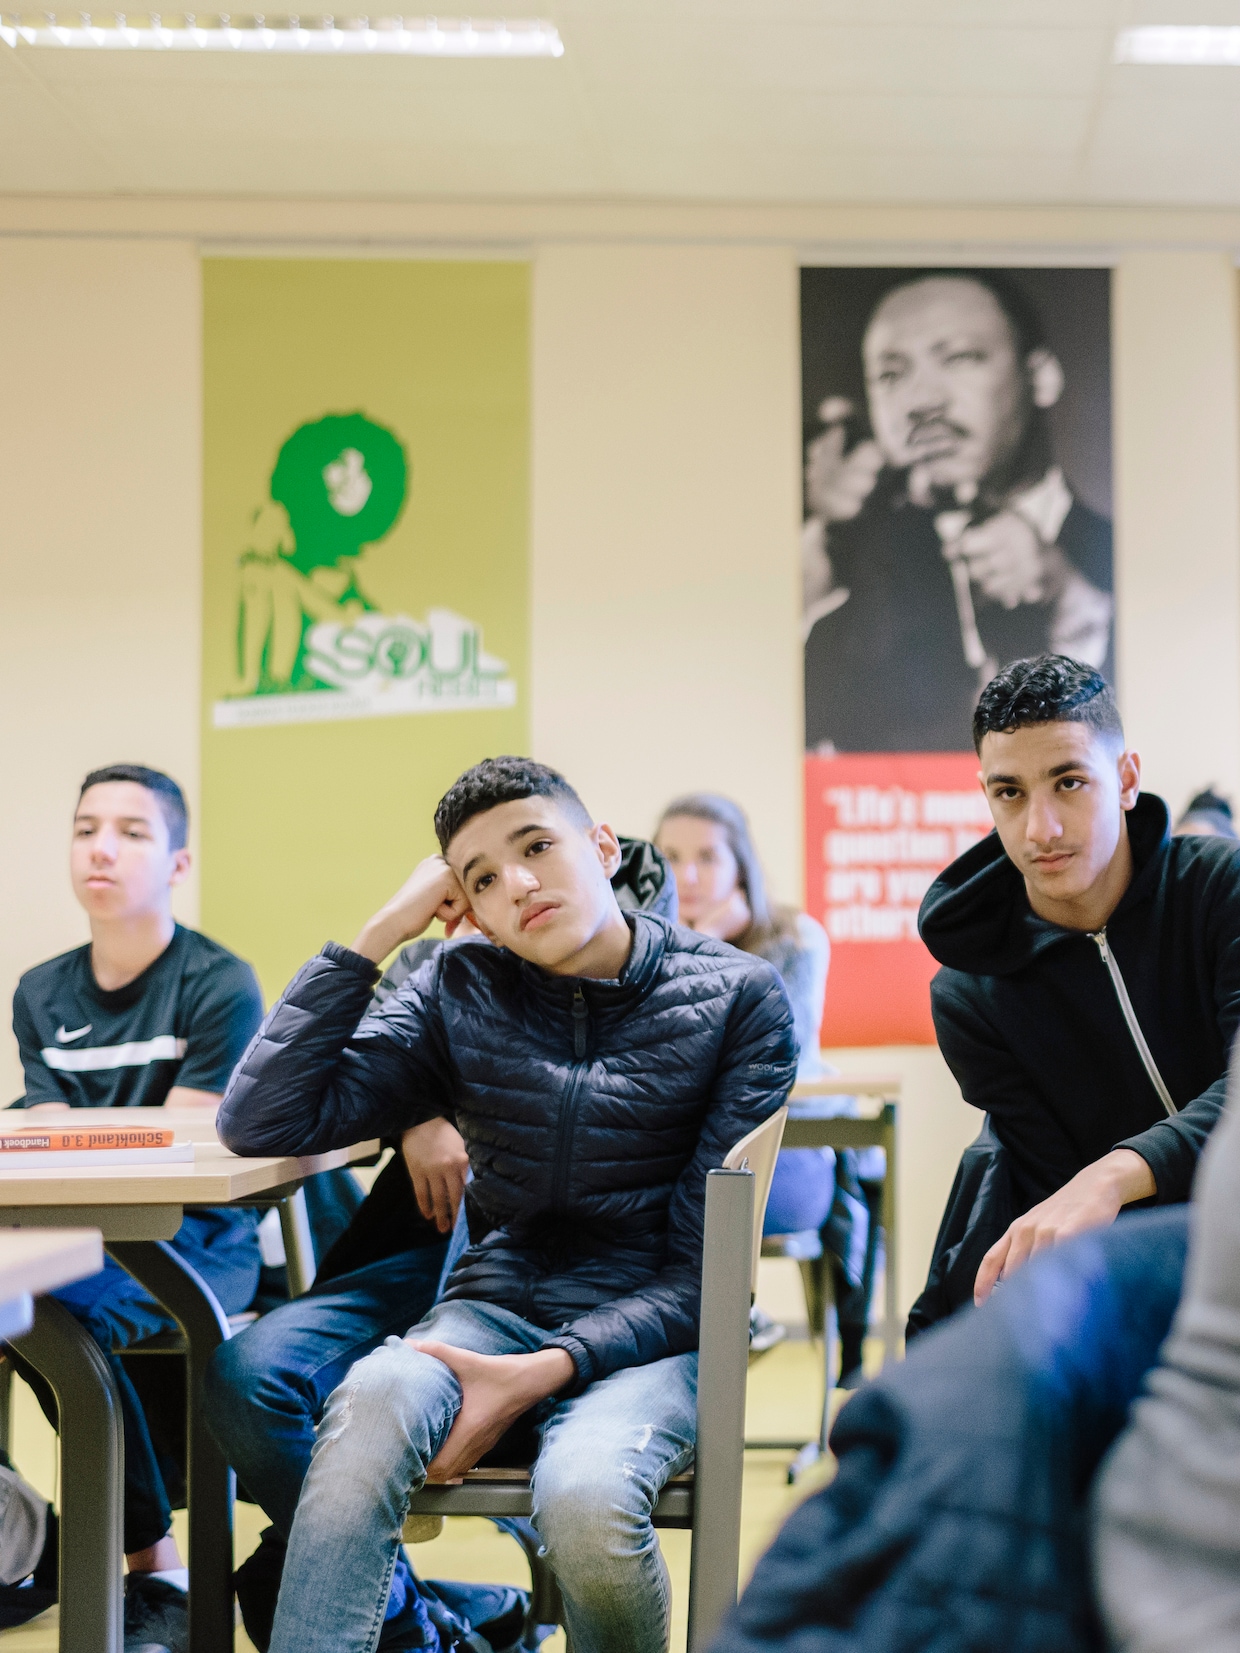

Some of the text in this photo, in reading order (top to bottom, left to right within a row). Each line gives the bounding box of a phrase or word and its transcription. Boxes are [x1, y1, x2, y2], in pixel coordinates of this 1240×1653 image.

[310, 622, 507, 681] SOUL
[4, 1138, 50, 1149] Handboek
[61, 1134, 84, 1147] 3.0
[88, 1132, 163, 1148] Schokland
